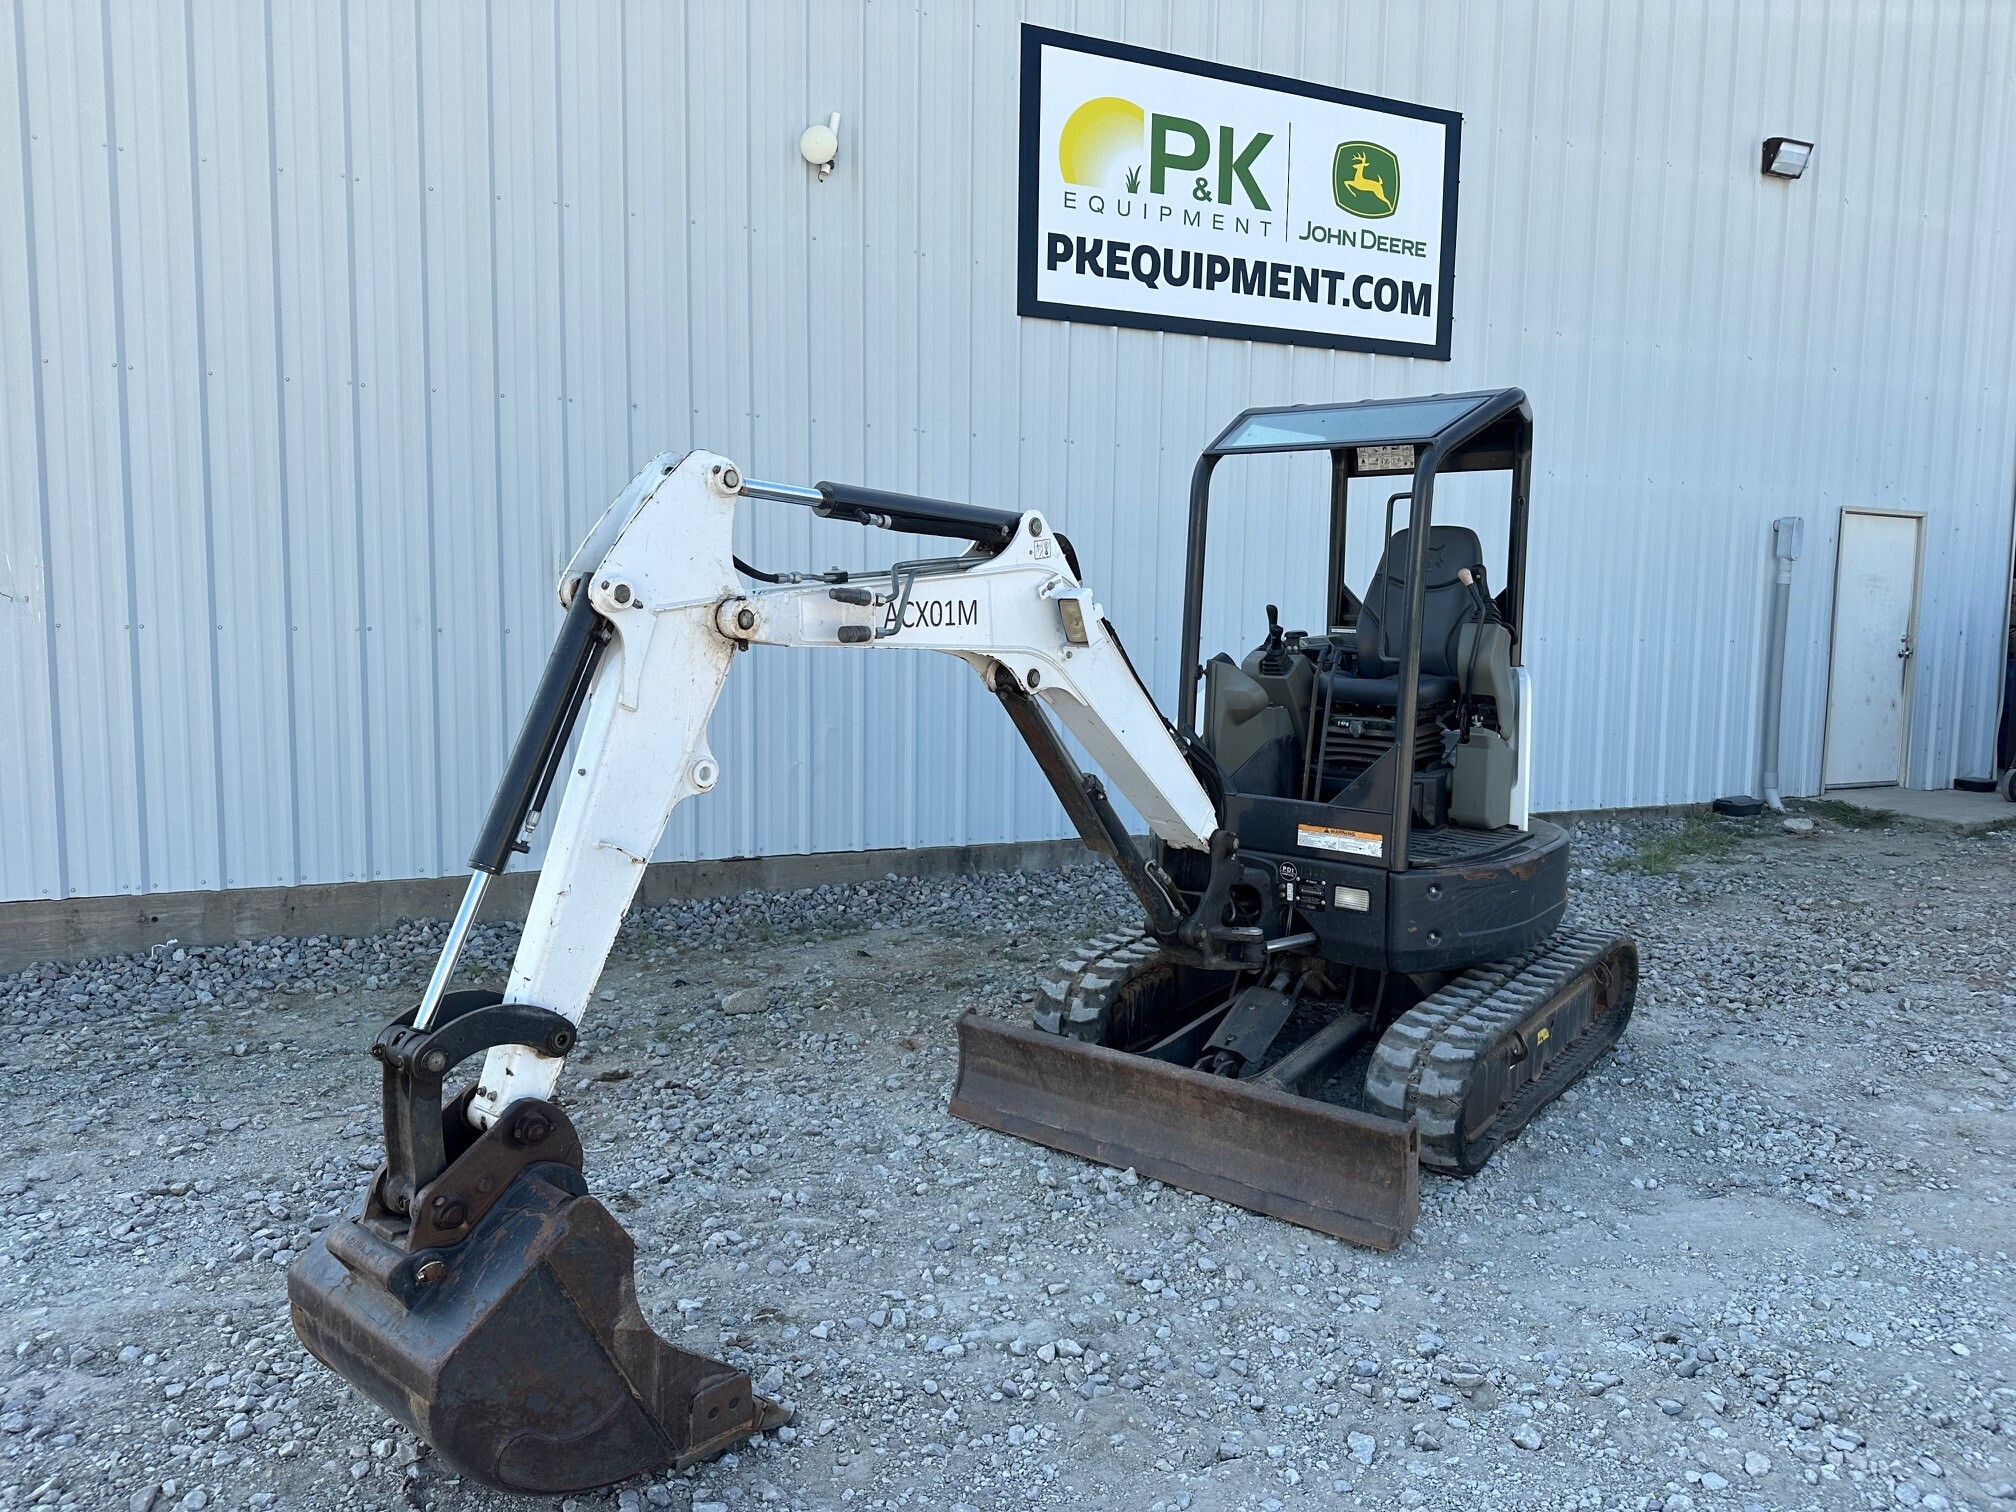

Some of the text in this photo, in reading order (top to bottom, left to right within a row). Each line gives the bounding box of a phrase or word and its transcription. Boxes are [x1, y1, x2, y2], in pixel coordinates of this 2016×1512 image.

[1150, 113, 1274, 212] P&K
[1064, 191, 1272, 237] EQUIPMENT
[1299, 220, 1427, 258] JOHN DEERE
[1046, 232, 1432, 317] PKEQUIPMENT.COM
[884, 599, 978, 629] ACX01M
[1330, 829, 1356, 837] WARNING
[1282, 865, 1294, 873] PDI
